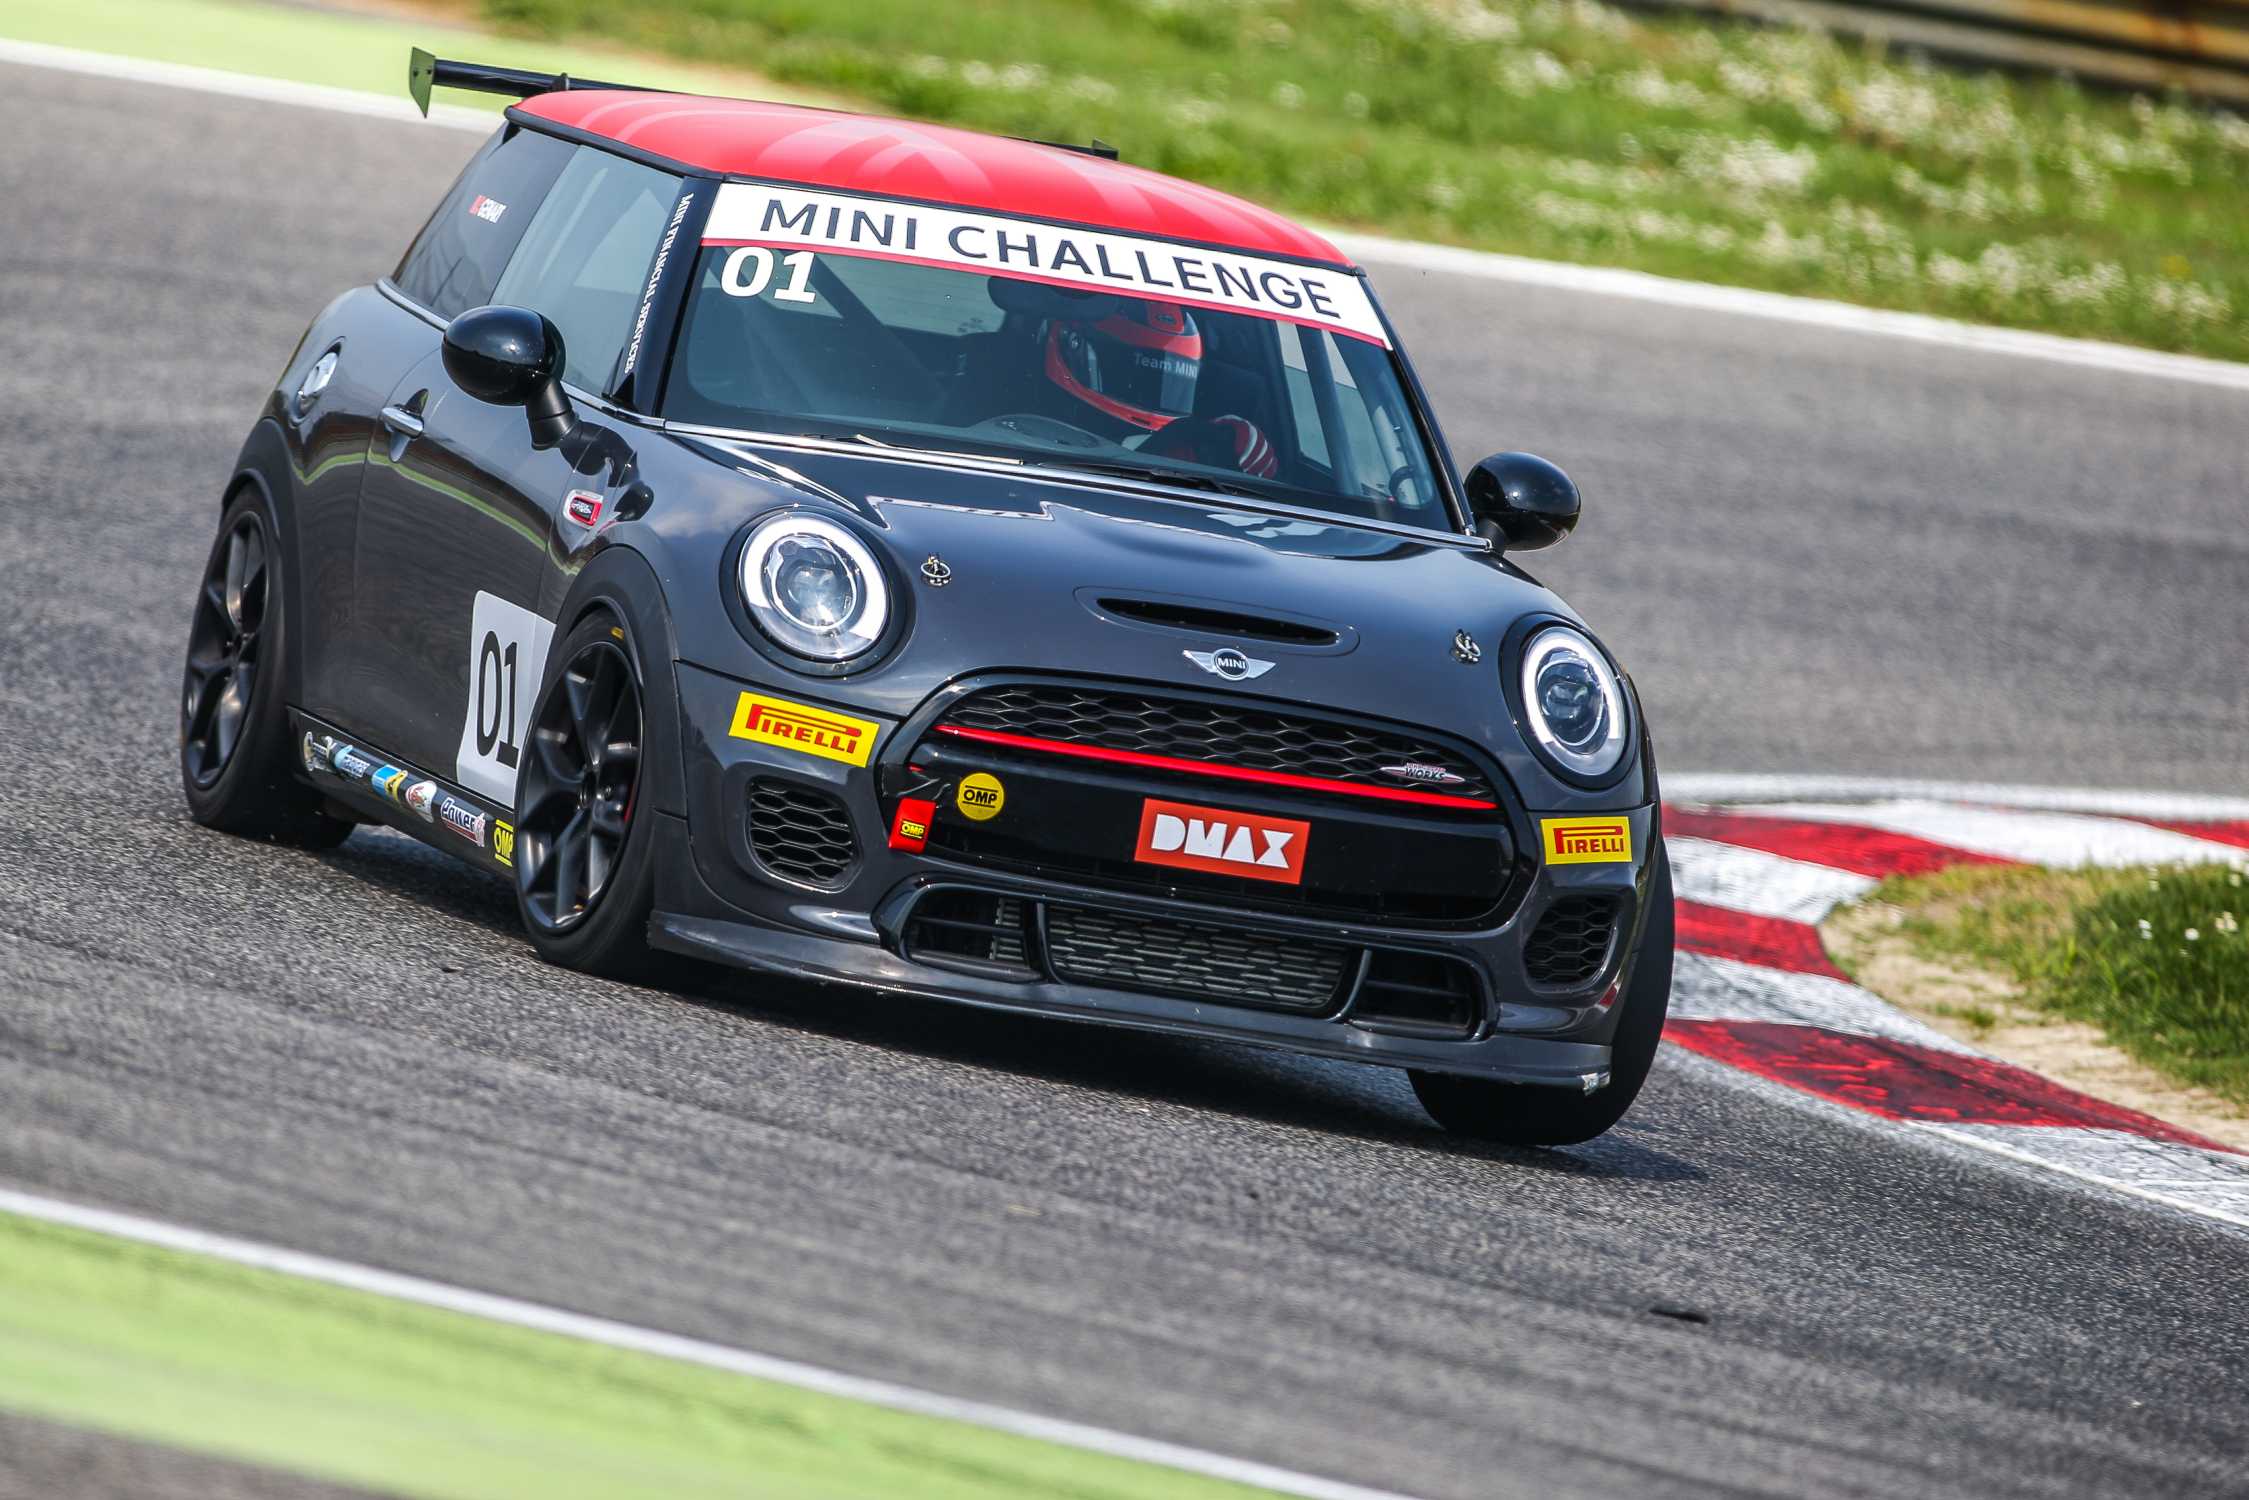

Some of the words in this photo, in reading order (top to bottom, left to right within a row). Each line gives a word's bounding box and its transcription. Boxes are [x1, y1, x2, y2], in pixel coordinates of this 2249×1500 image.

[719, 246, 818, 304] 01
[759, 198, 918, 250] MINI
[946, 223, 1342, 320] CHALLENGE
[624, 302, 652, 375] SERVICES
[1134, 352, 1172, 372] Team
[1175, 361, 1198, 379] MINI
[1217, 657, 1246, 670] MINI
[476, 630, 520, 770] 01
[745, 703, 862, 755] PIRELLI
[963, 788, 998, 806] OMP
[494, 826, 514, 860] OMP
[901, 821, 925, 838] OMP
[1151, 813, 1294, 869] DMAX
[1552, 825, 1624, 855] PIRELLI
